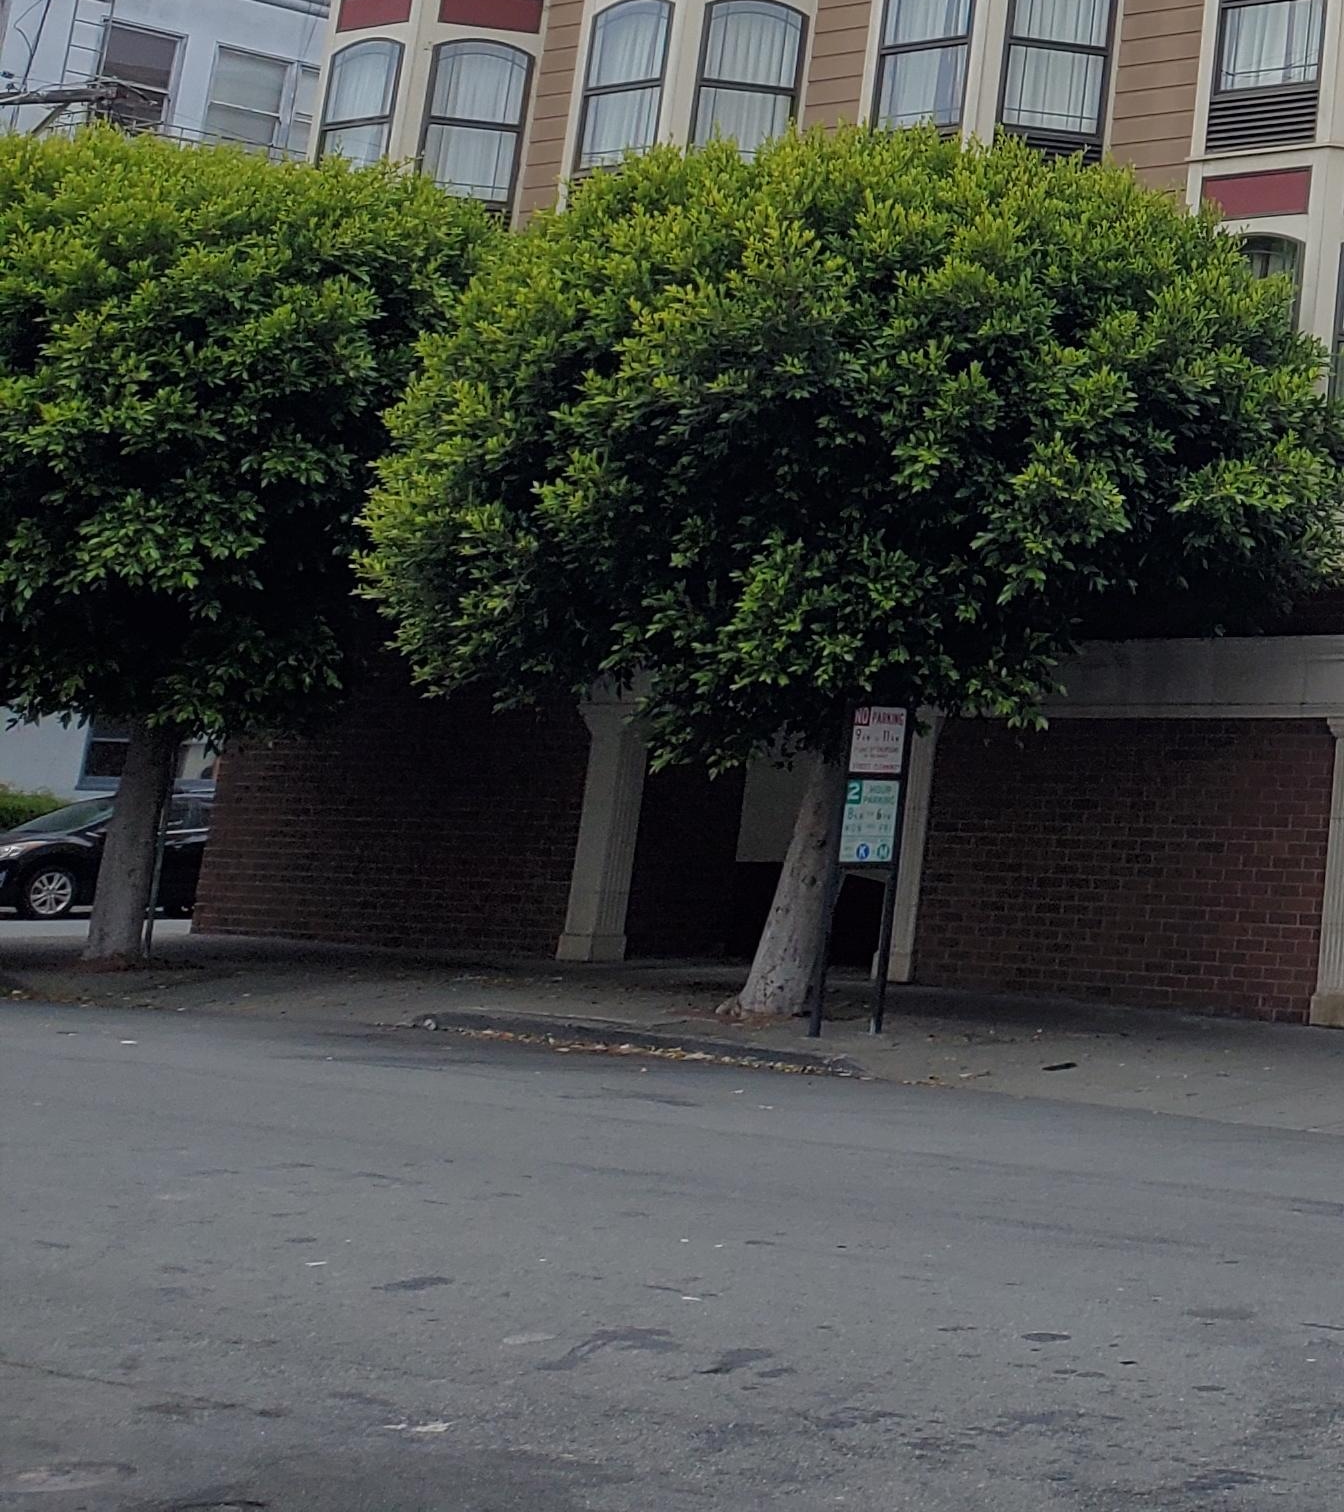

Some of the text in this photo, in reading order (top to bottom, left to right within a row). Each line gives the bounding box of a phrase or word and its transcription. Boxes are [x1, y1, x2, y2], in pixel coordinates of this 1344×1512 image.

[854, 707, 904, 726] NO PARKING
[849, 782, 860, 800] 2
